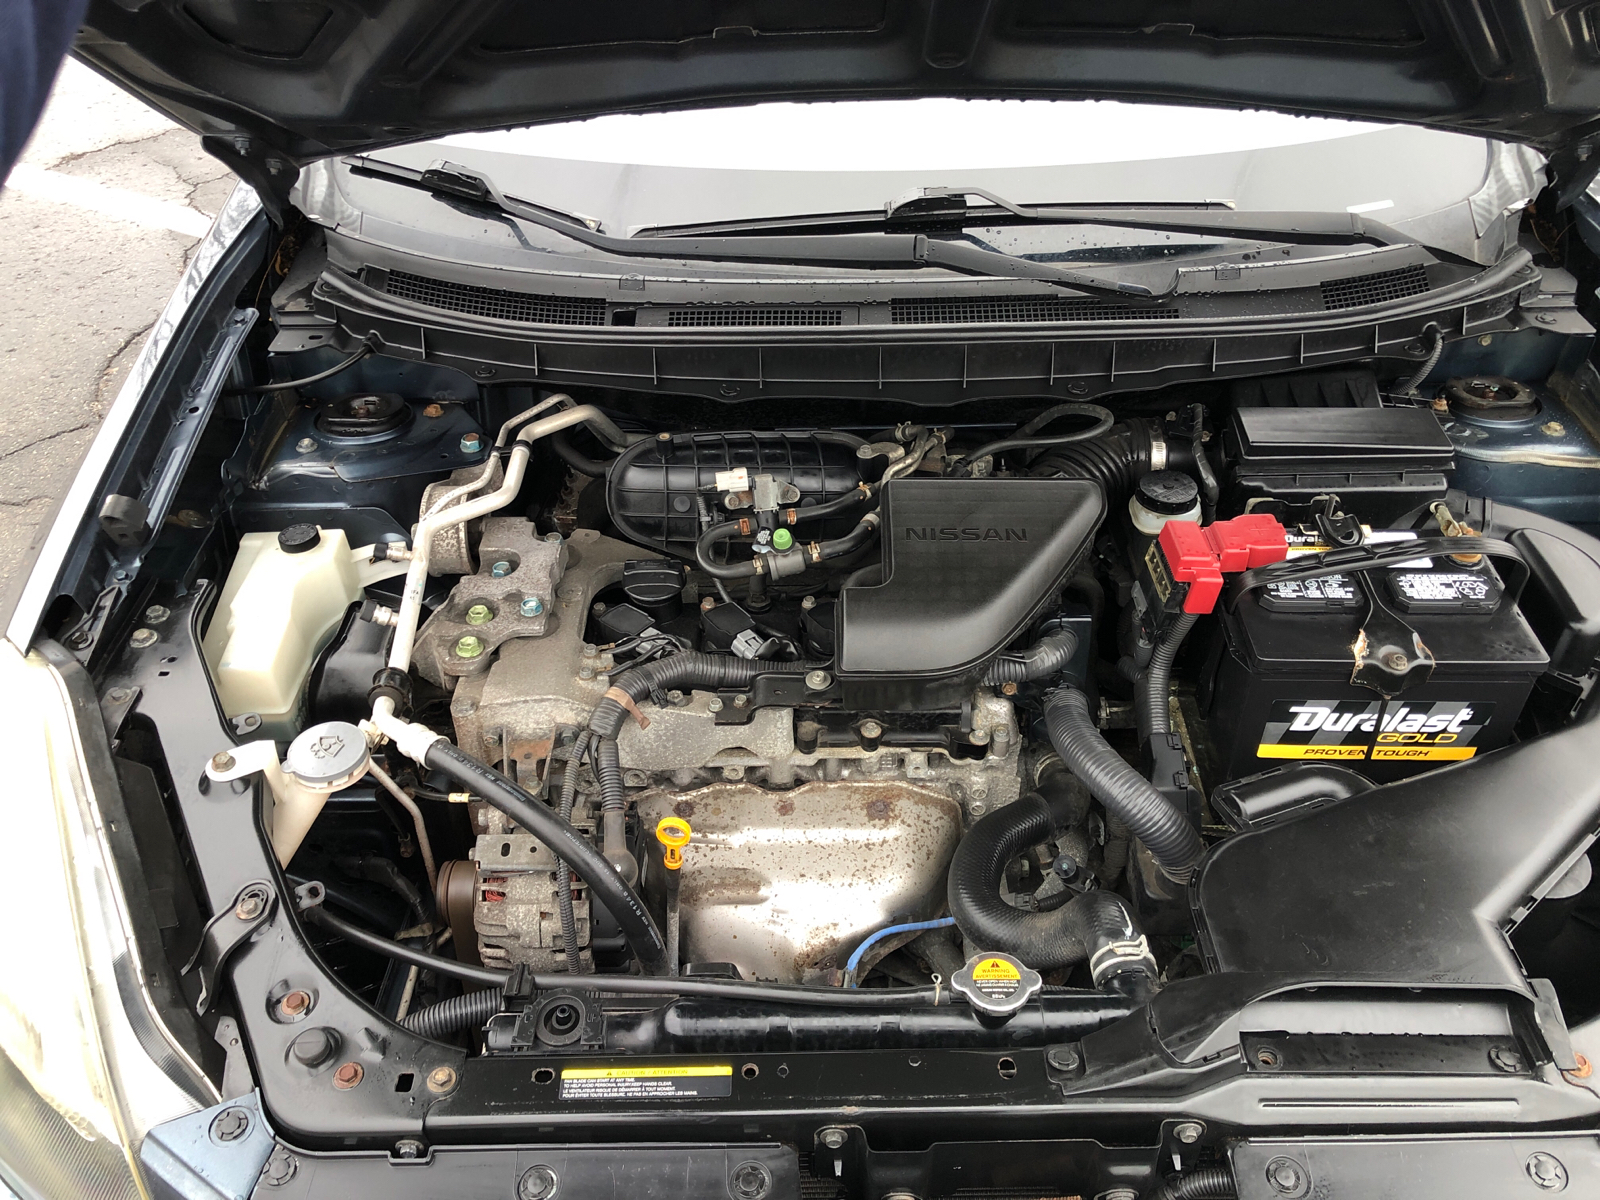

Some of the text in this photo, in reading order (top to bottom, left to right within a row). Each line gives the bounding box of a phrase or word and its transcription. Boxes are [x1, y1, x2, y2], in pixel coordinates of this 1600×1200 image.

[905, 527, 1028, 542] NISSAN
[1288, 705, 1474, 733] Duralast
[1376, 732, 1458, 743] GOLD
[1303, 748, 1429, 757] PROVEN TOUGH
